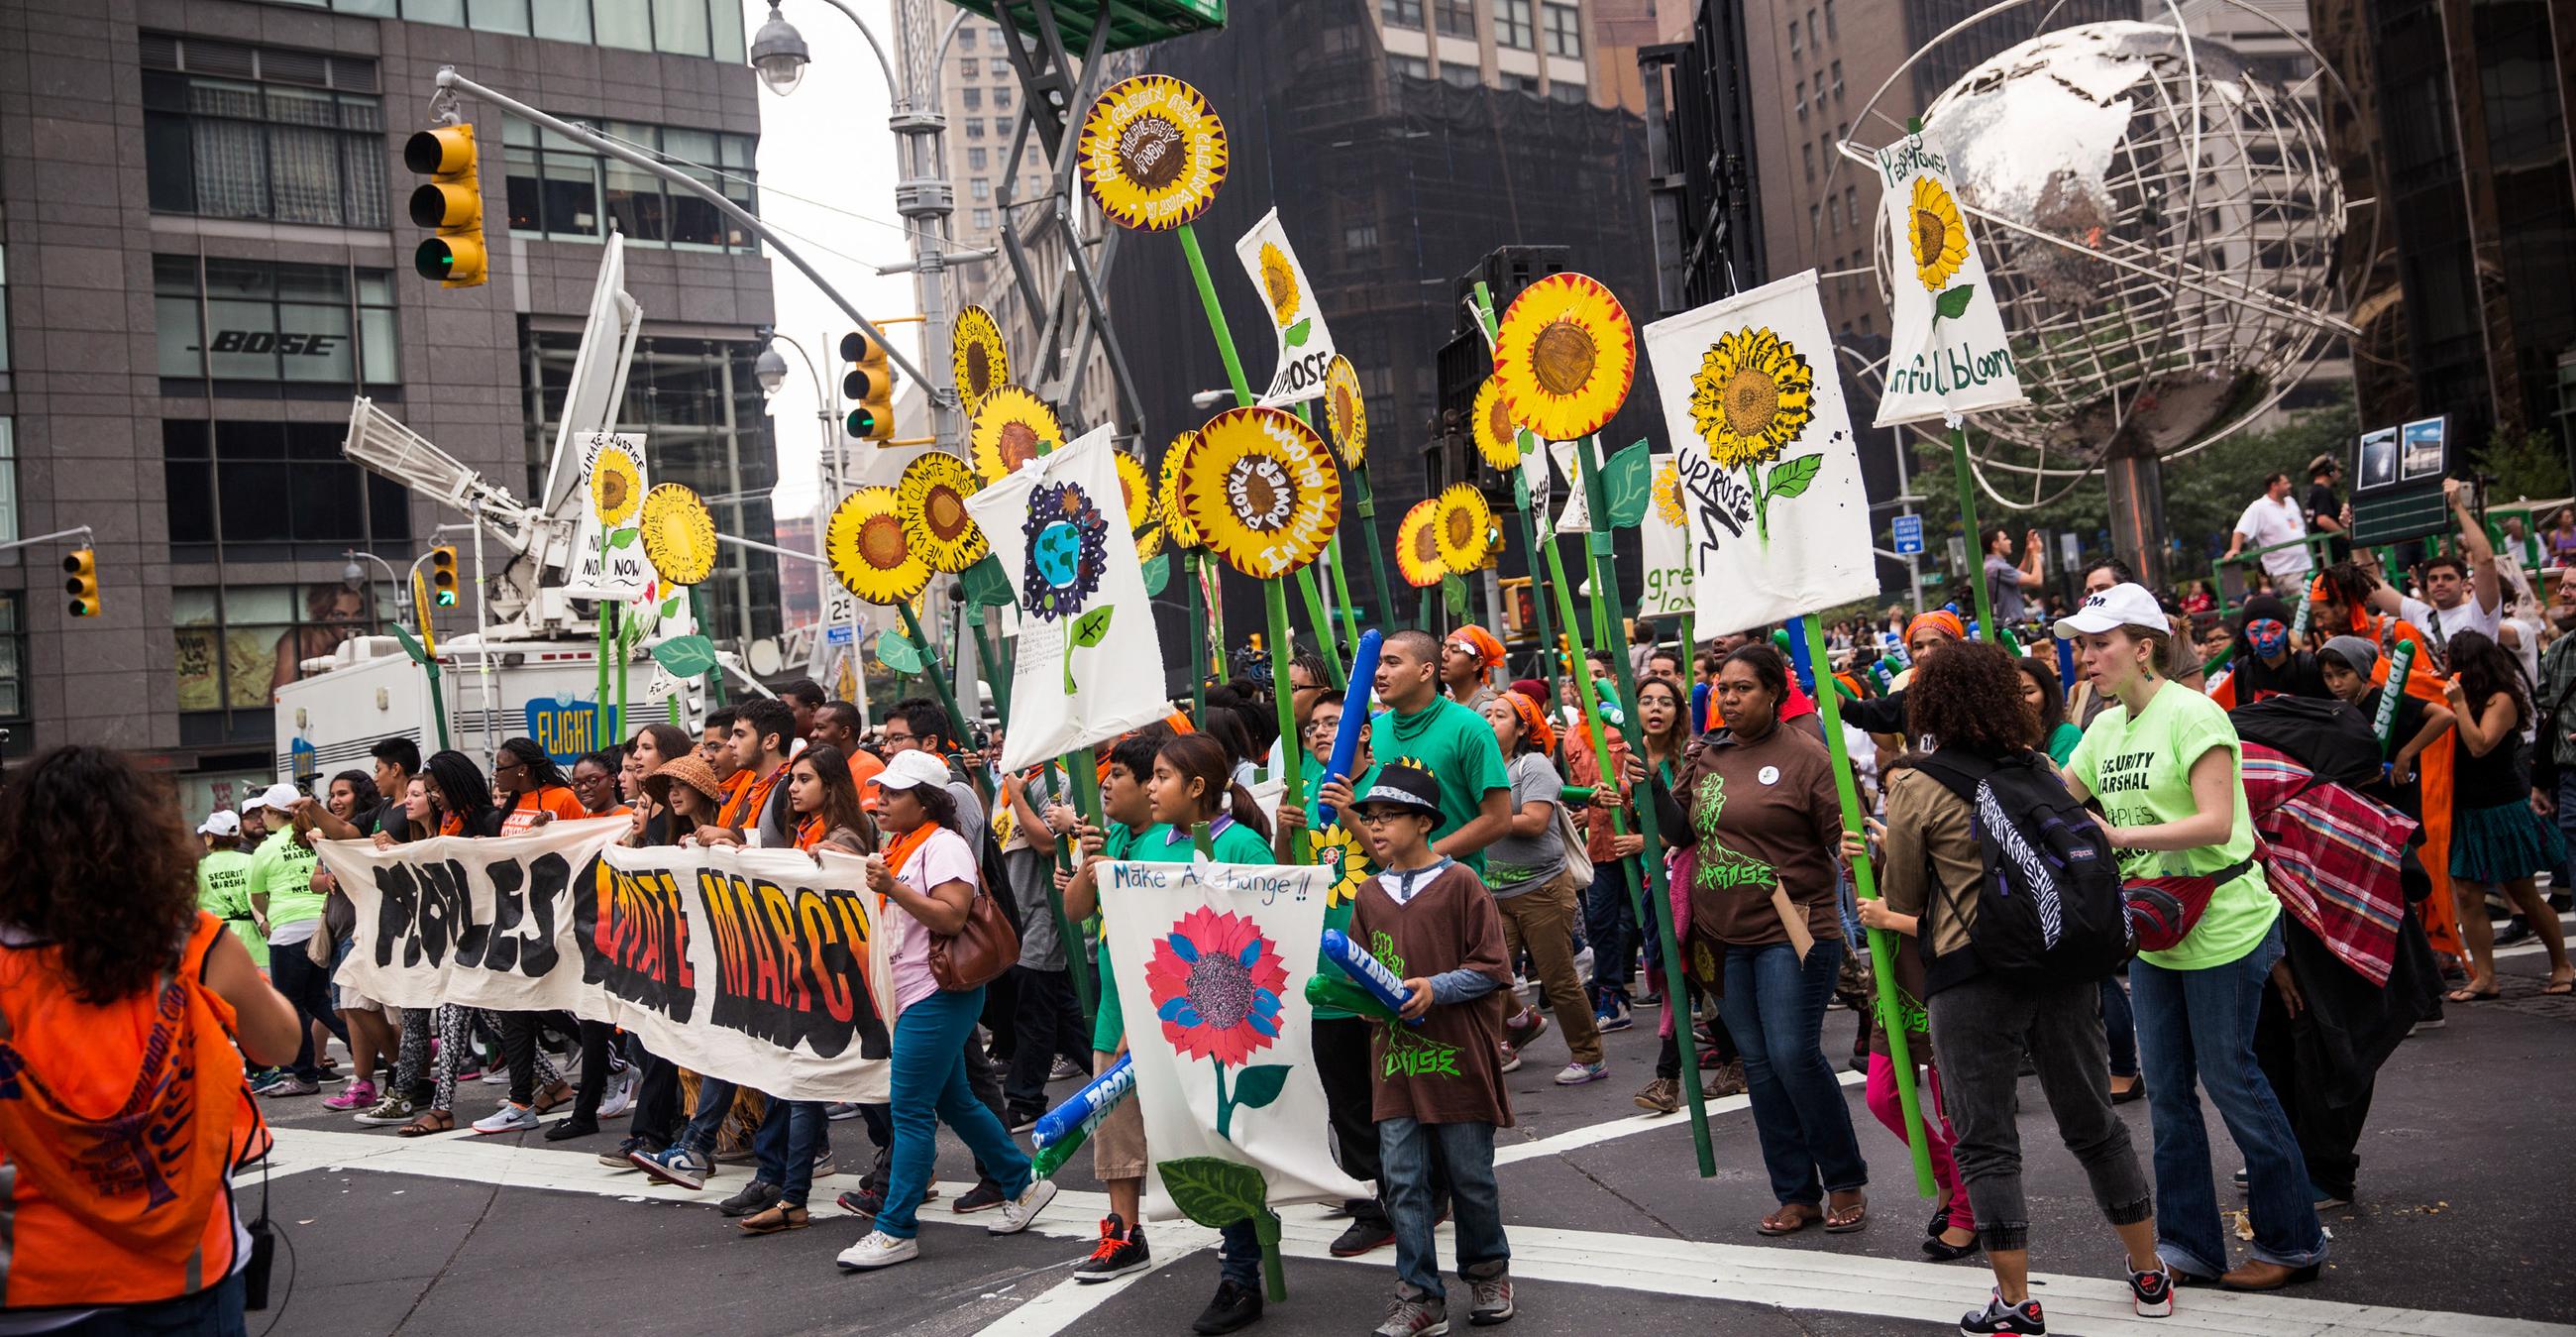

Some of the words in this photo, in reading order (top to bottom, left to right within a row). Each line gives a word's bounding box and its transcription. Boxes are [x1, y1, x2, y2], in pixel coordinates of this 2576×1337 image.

[1112, 85, 1165, 126] CLEAN
[1167, 93, 1202, 129] AIR
[1189, 133, 1212, 195] CLEAN
[1120, 118, 1180, 160] HEALTHY
[1133, 140, 1166, 174] FOOD
[186, 330, 347, 357] BOSE
[1948, 342, 2016, 390] bloom
[609, 432, 645, 472] JUSTICE
[909, 462, 944, 501] CLIMATE
[950, 467, 977, 496] JUST
[1229, 457, 1263, 530] PEOPLE
[1256, 454, 1290, 528] POWER
[1677, 446, 1754, 533] UPROSE
[907, 502, 926, 548] WANT
[1260, 539, 1299, 574] IN
[1293, 496, 1326, 545] FULL
[614, 558, 642, 577] NOW
[831, 599, 851, 620] 25
[2374, 649, 2410, 740] UPROSE
[537, 709, 596, 755] FLIGHT
[2097, 772, 2150, 794] ARSHAL
[283, 849, 318, 862] MARSH
[210, 878, 248, 890] MARSHA
[1113, 863, 1167, 889] Make
[1696, 862, 1777, 891] UPROSE
[698, 865, 894, 1060] MARCH
